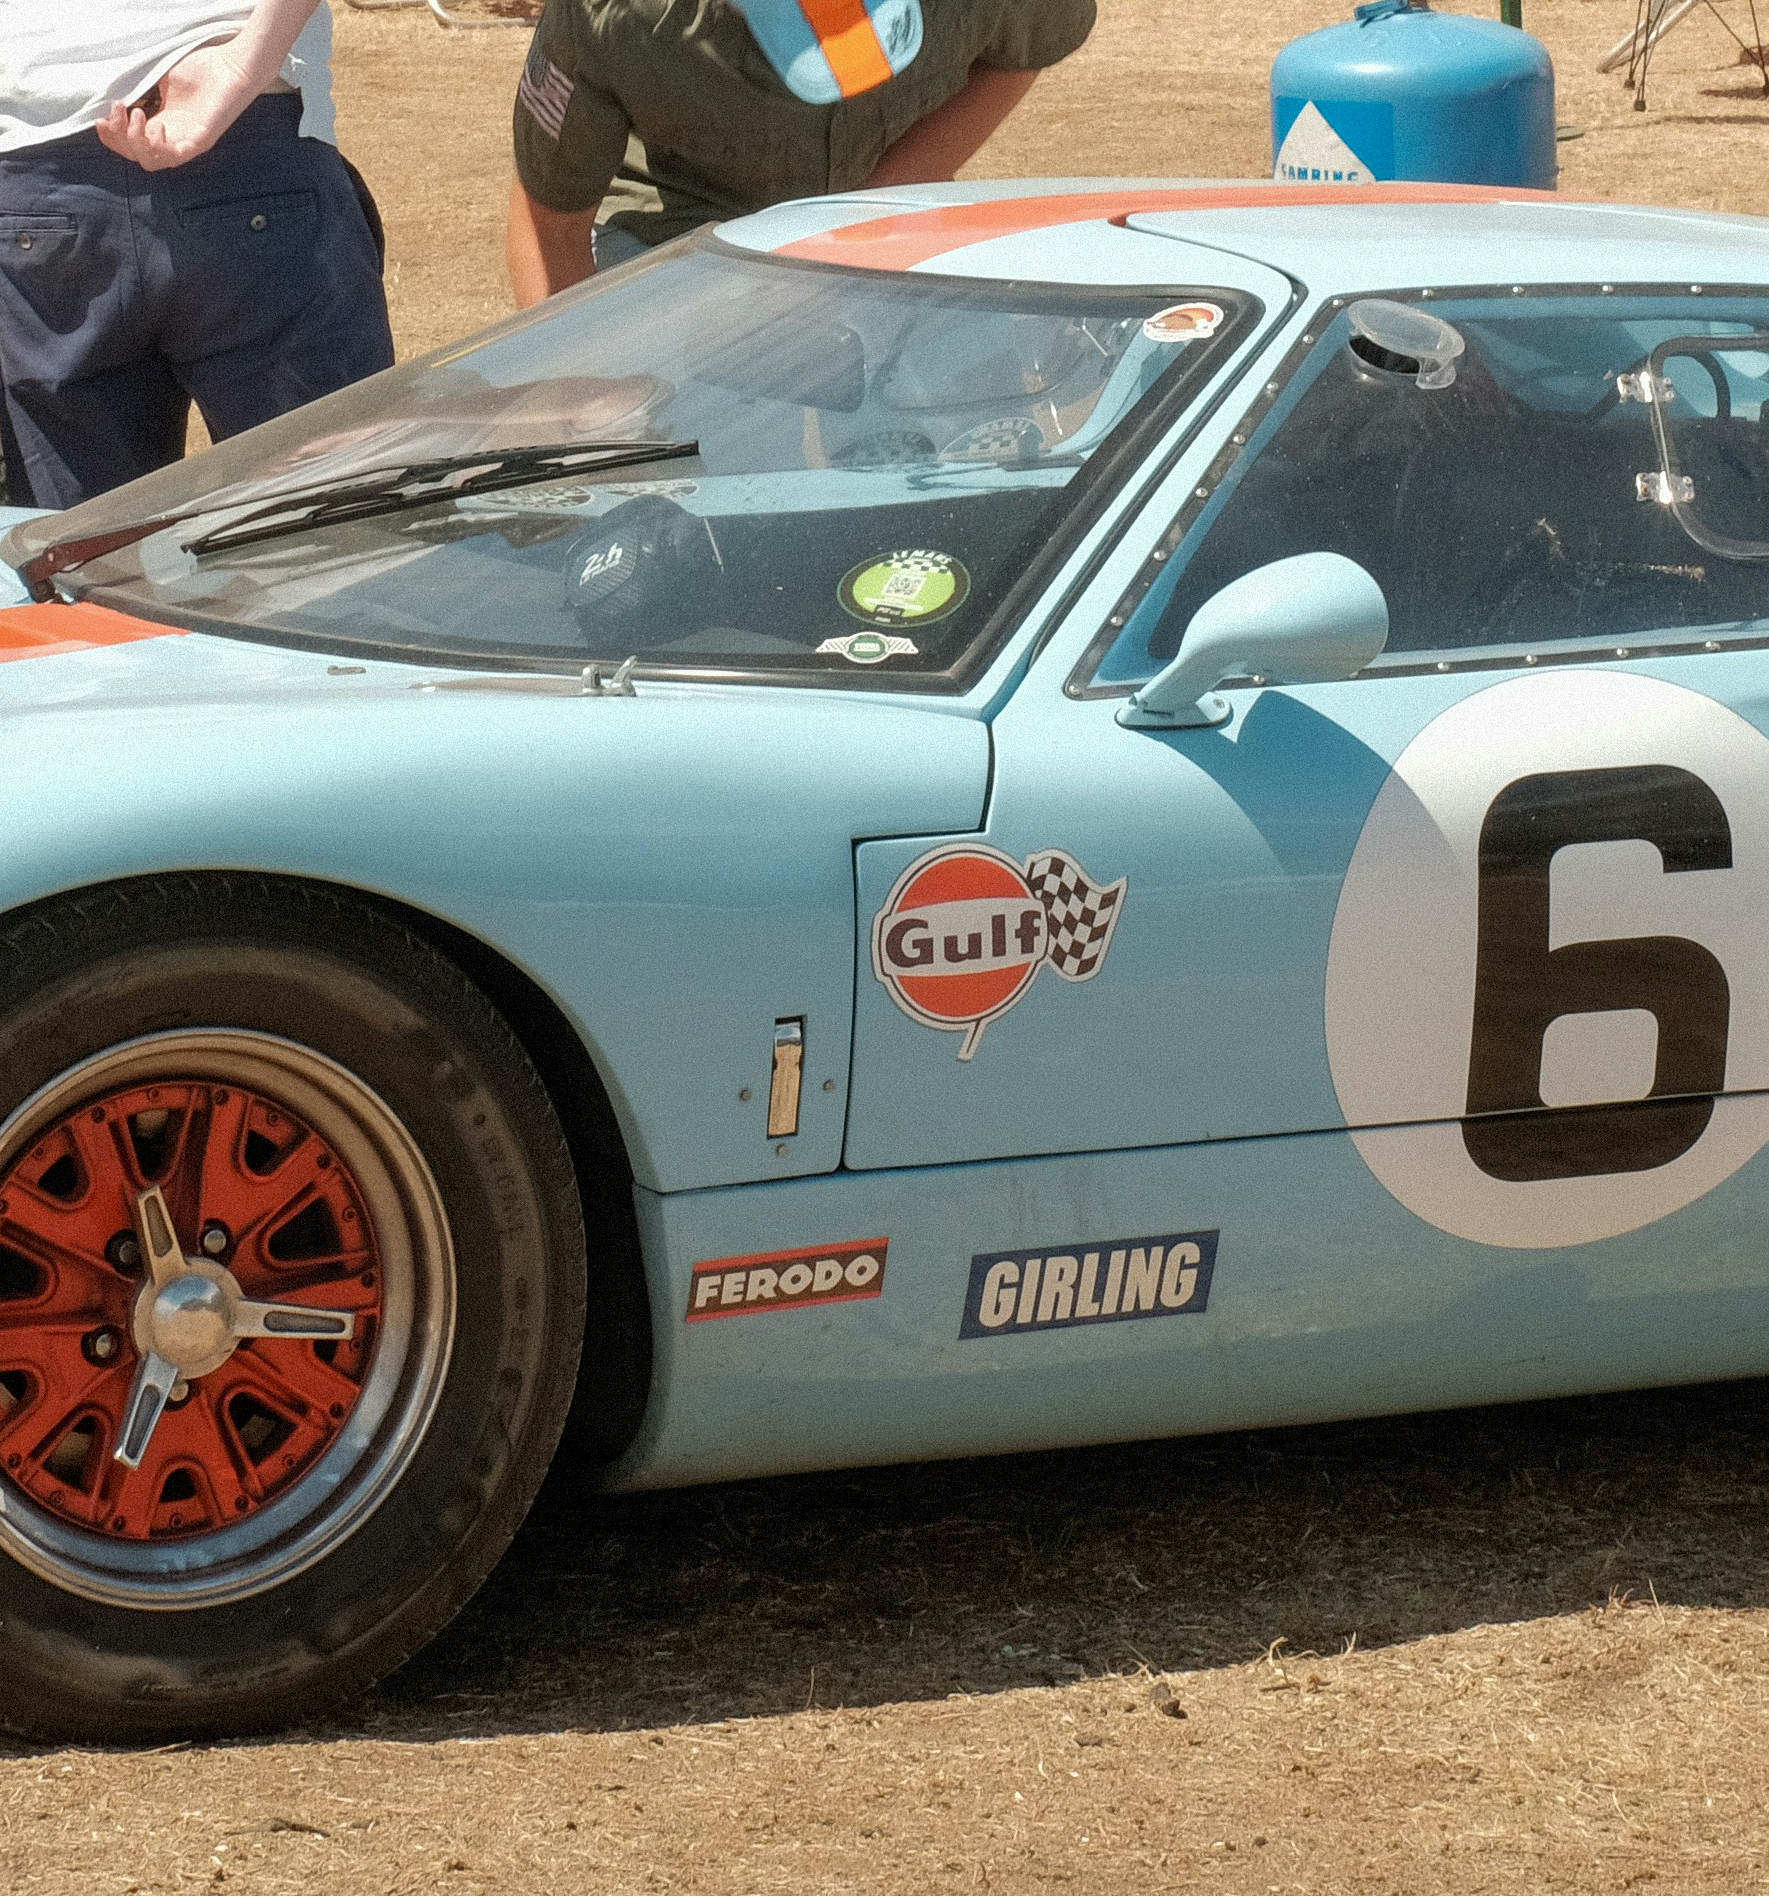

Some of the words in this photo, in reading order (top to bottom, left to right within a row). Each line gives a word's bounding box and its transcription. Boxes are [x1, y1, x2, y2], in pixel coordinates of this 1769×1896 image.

[885, 908, 1044, 969] Gulf
[1460, 762, 1735, 1184] 6
[694, 1253, 880, 1308] FERODO
[978, 1241, 1200, 1328] GIRLING
